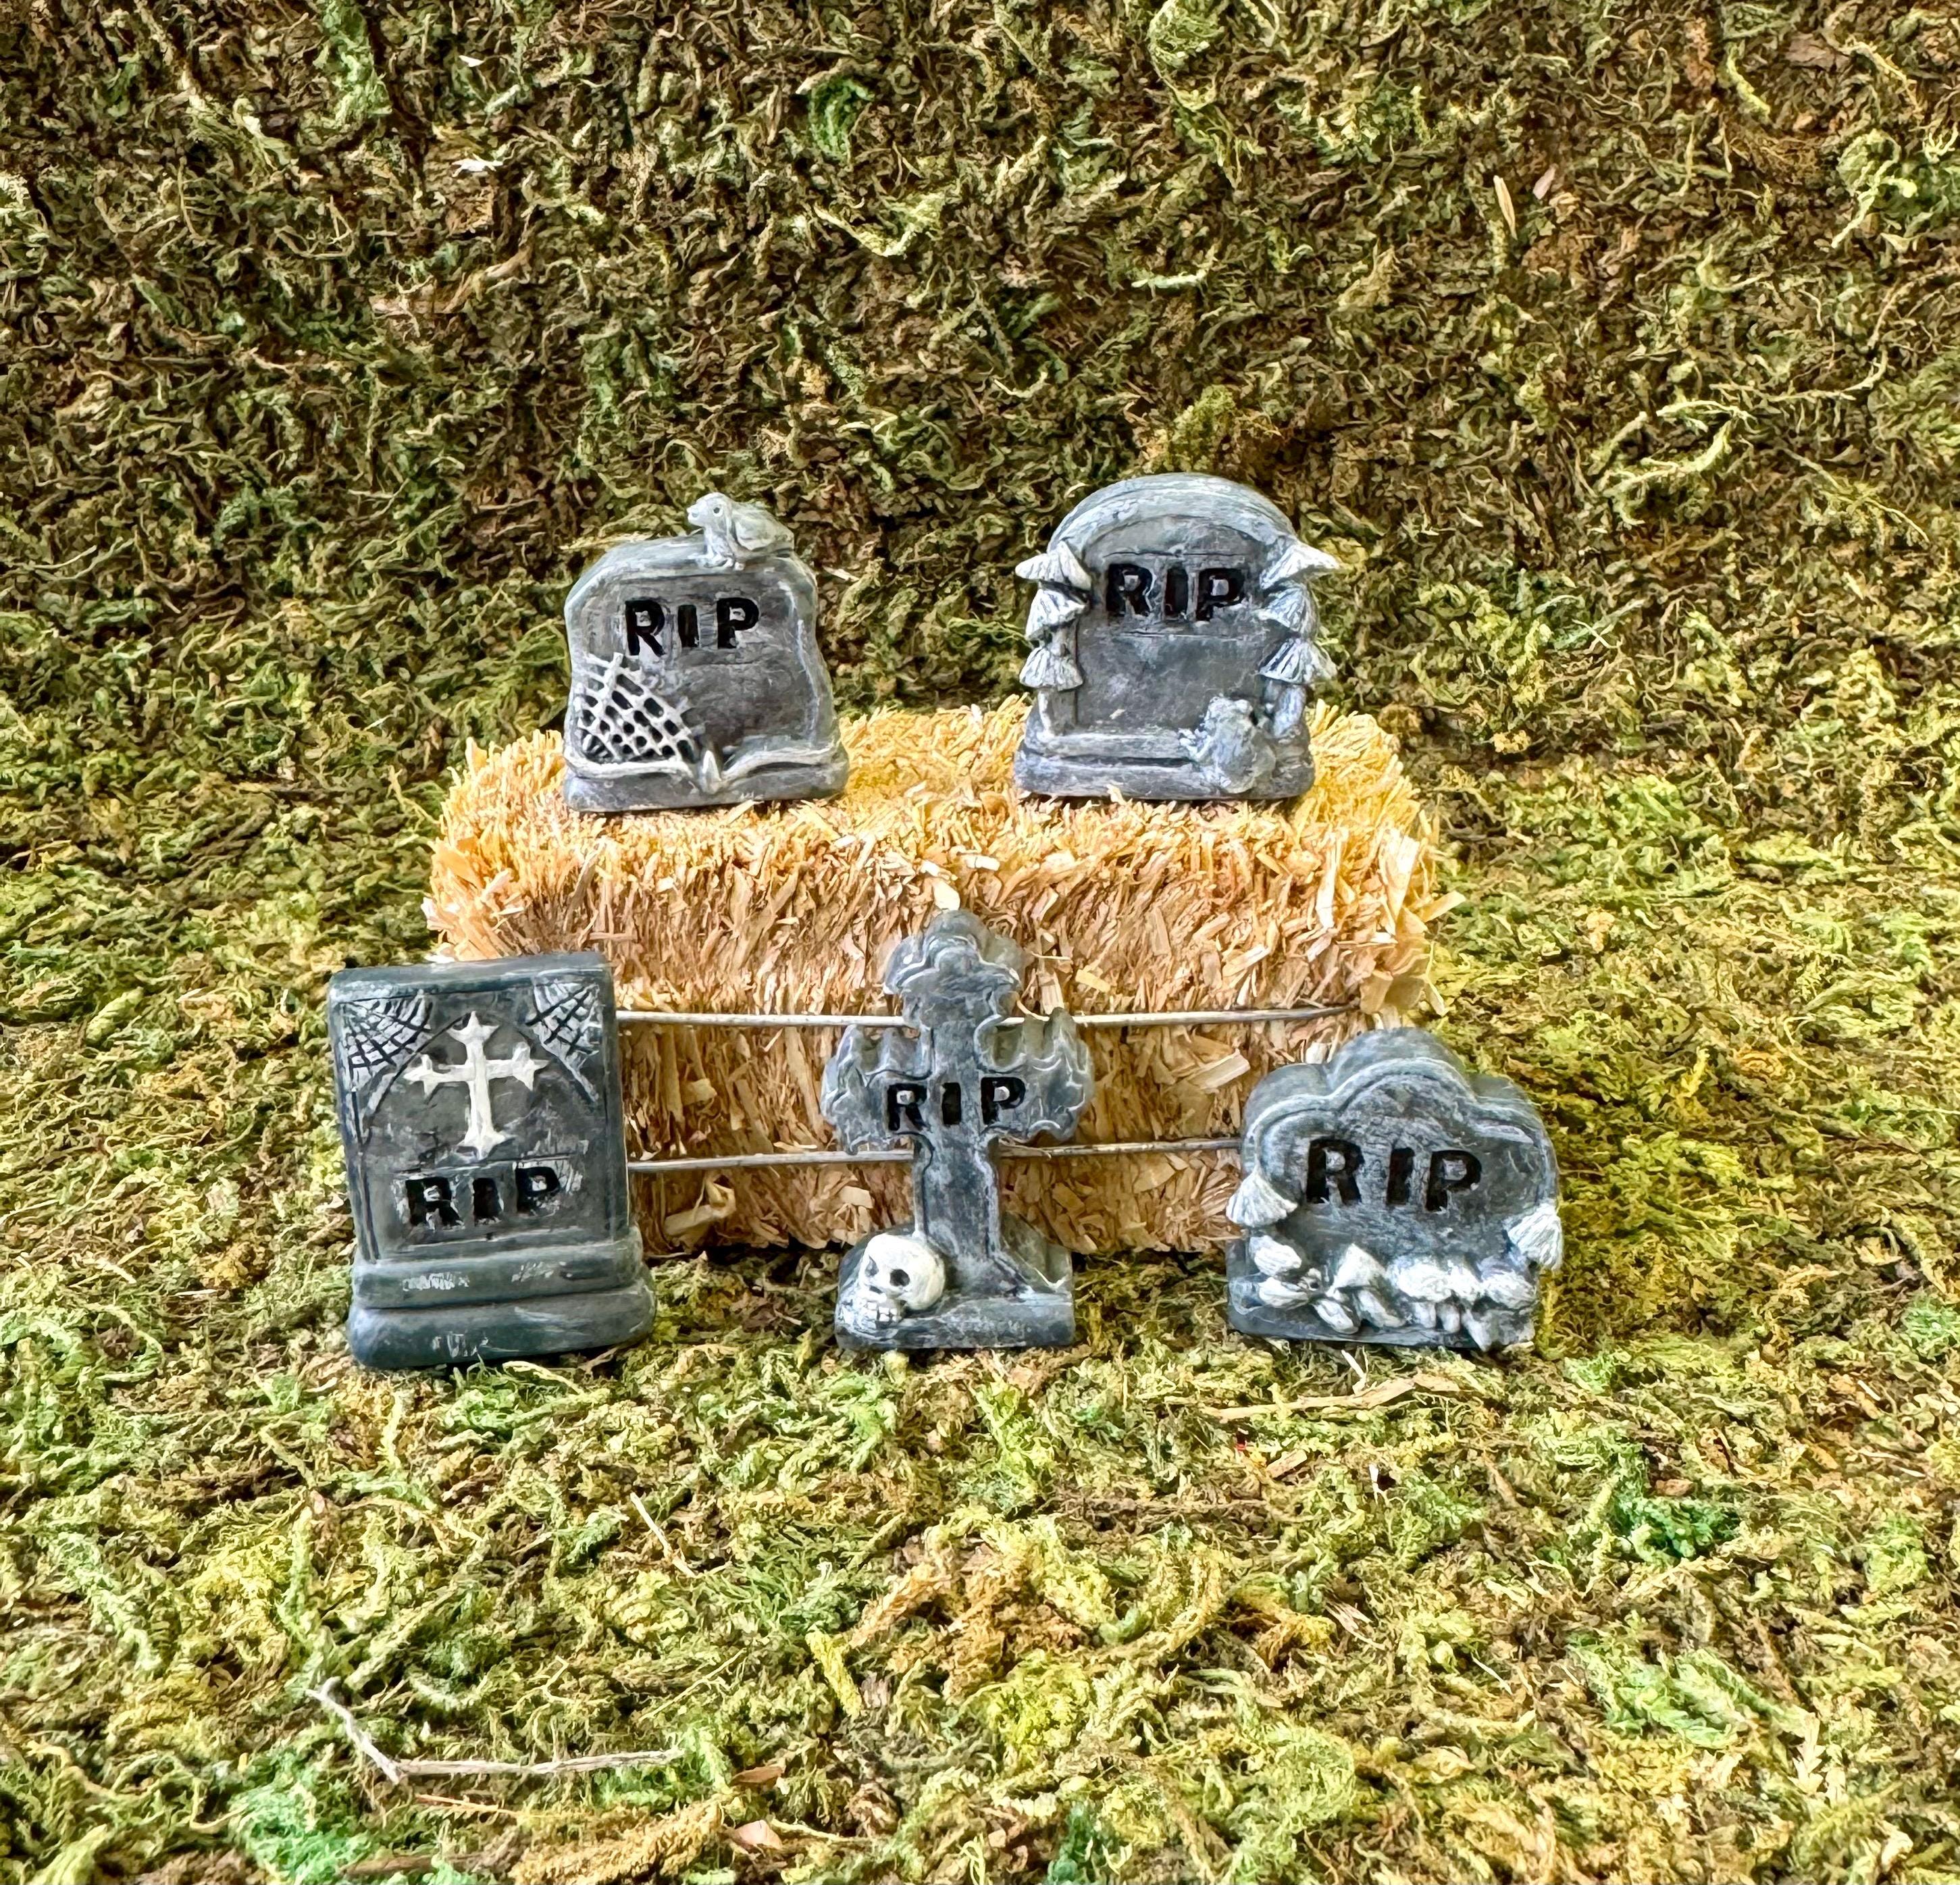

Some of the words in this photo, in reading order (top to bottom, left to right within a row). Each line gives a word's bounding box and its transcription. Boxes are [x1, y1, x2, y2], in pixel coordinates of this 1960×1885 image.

[1106, 563, 1244, 621] RIP
[625, 597, 760, 657] RIP
[887, 1077, 1026, 1132] RIP
[405, 1166, 560, 1229] RIP
[1306, 1137, 1482, 1212] RIP
